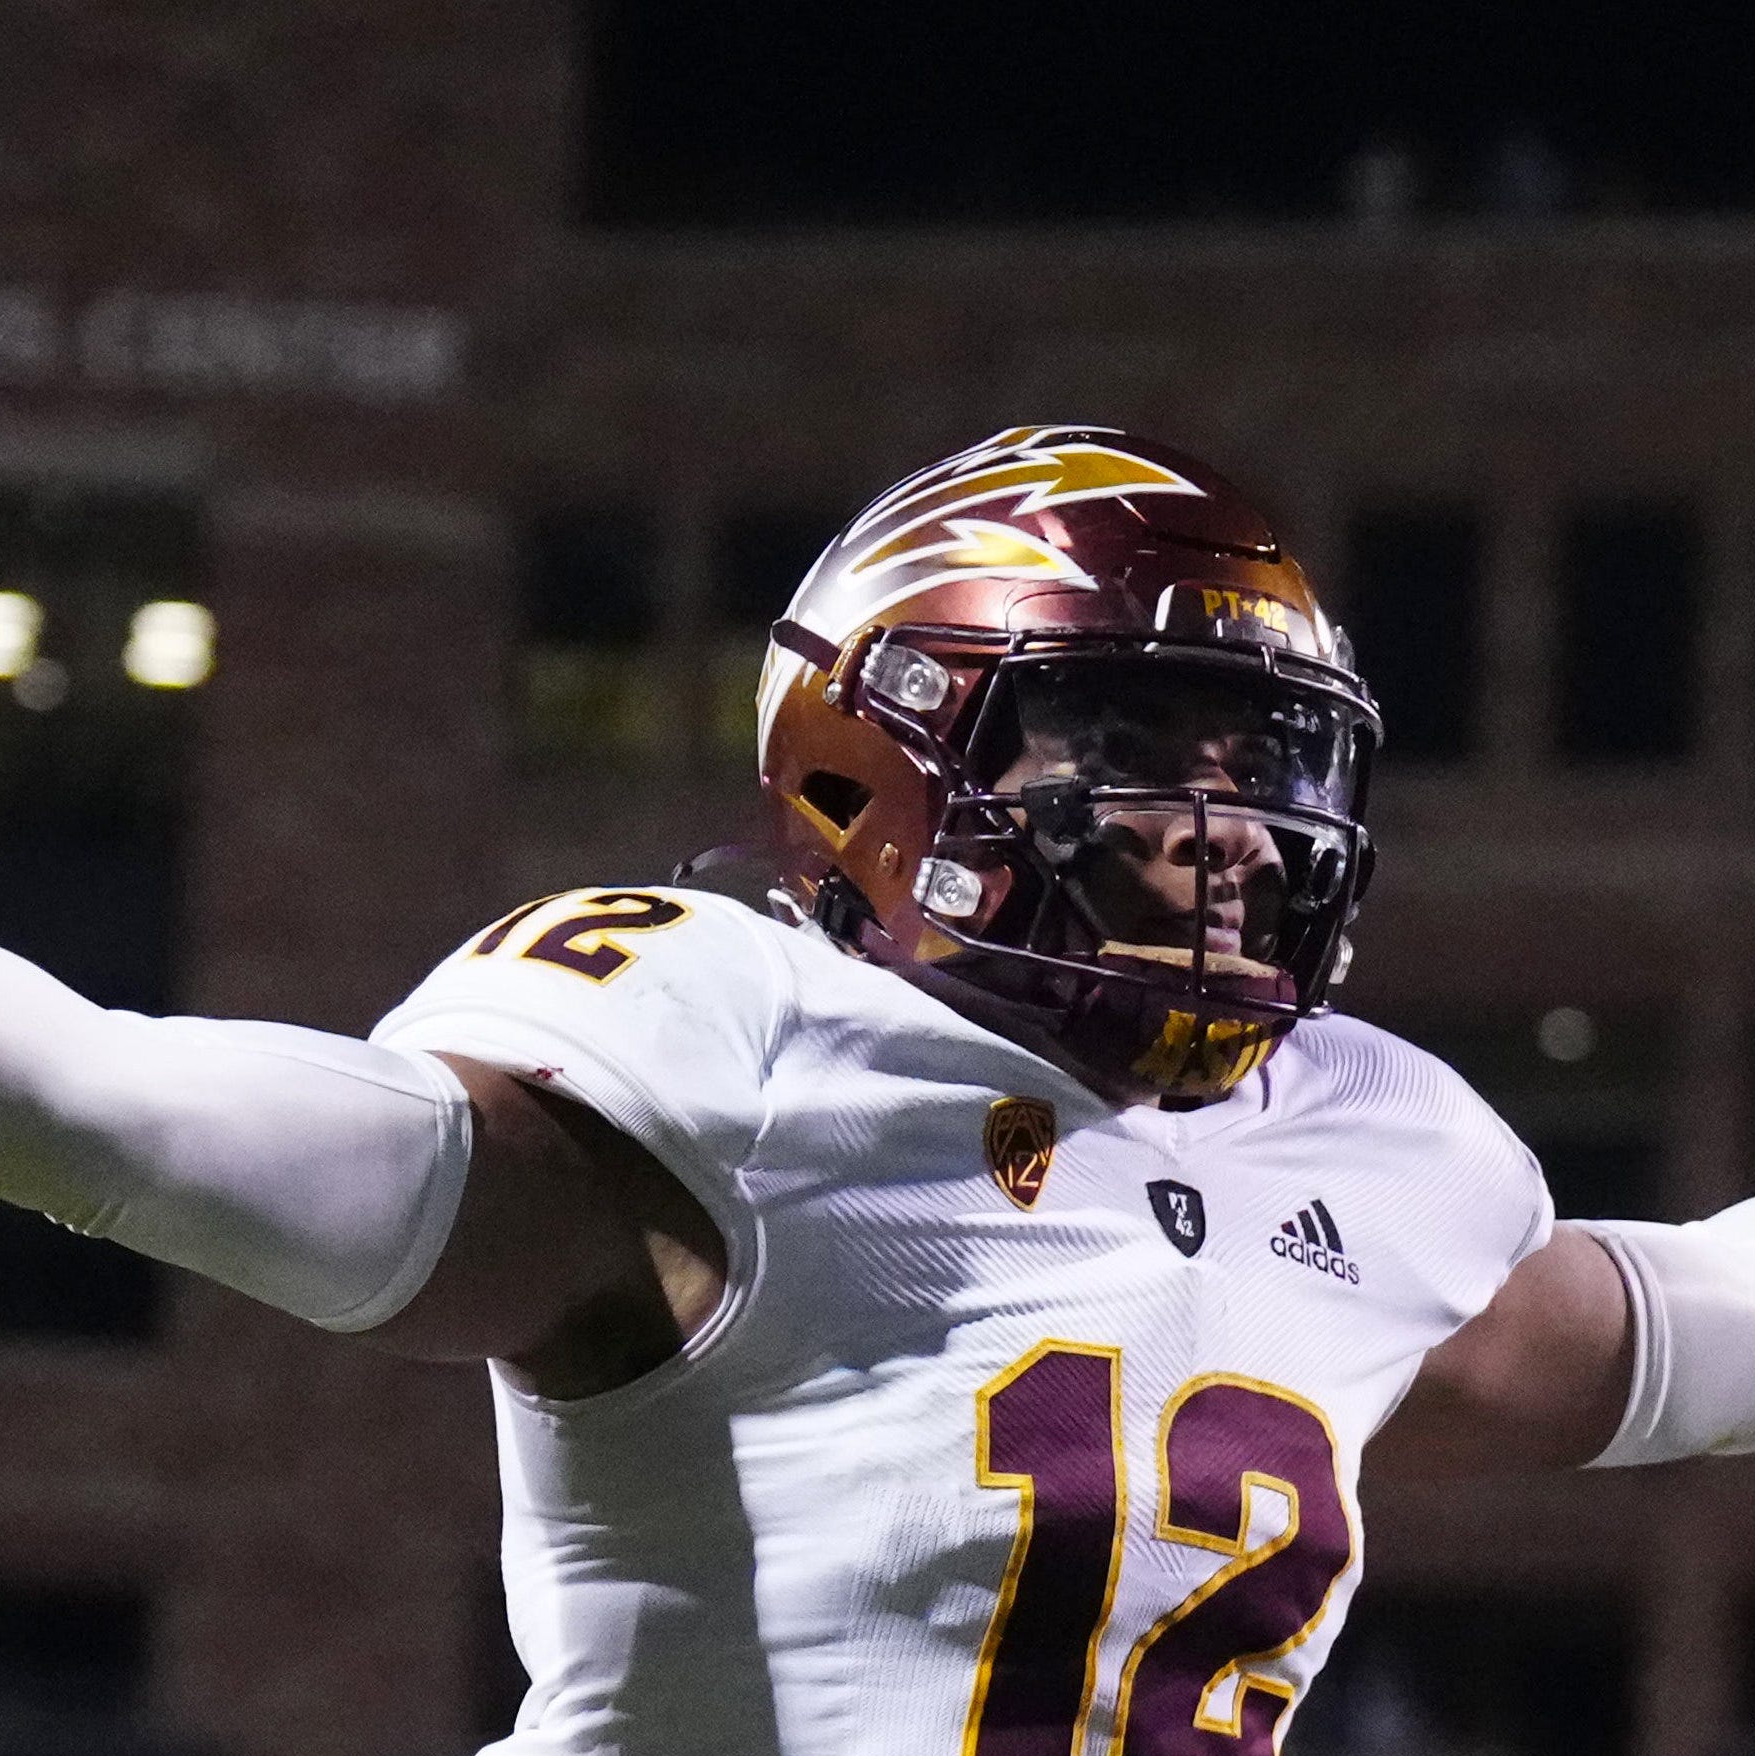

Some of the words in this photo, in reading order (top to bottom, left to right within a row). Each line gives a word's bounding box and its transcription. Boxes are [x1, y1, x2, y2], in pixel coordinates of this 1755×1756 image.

[1167, 1191, 1188, 1212] PT
[1175, 1216, 1195, 1237] 42
[1270, 1236, 1360, 1285] adidas
